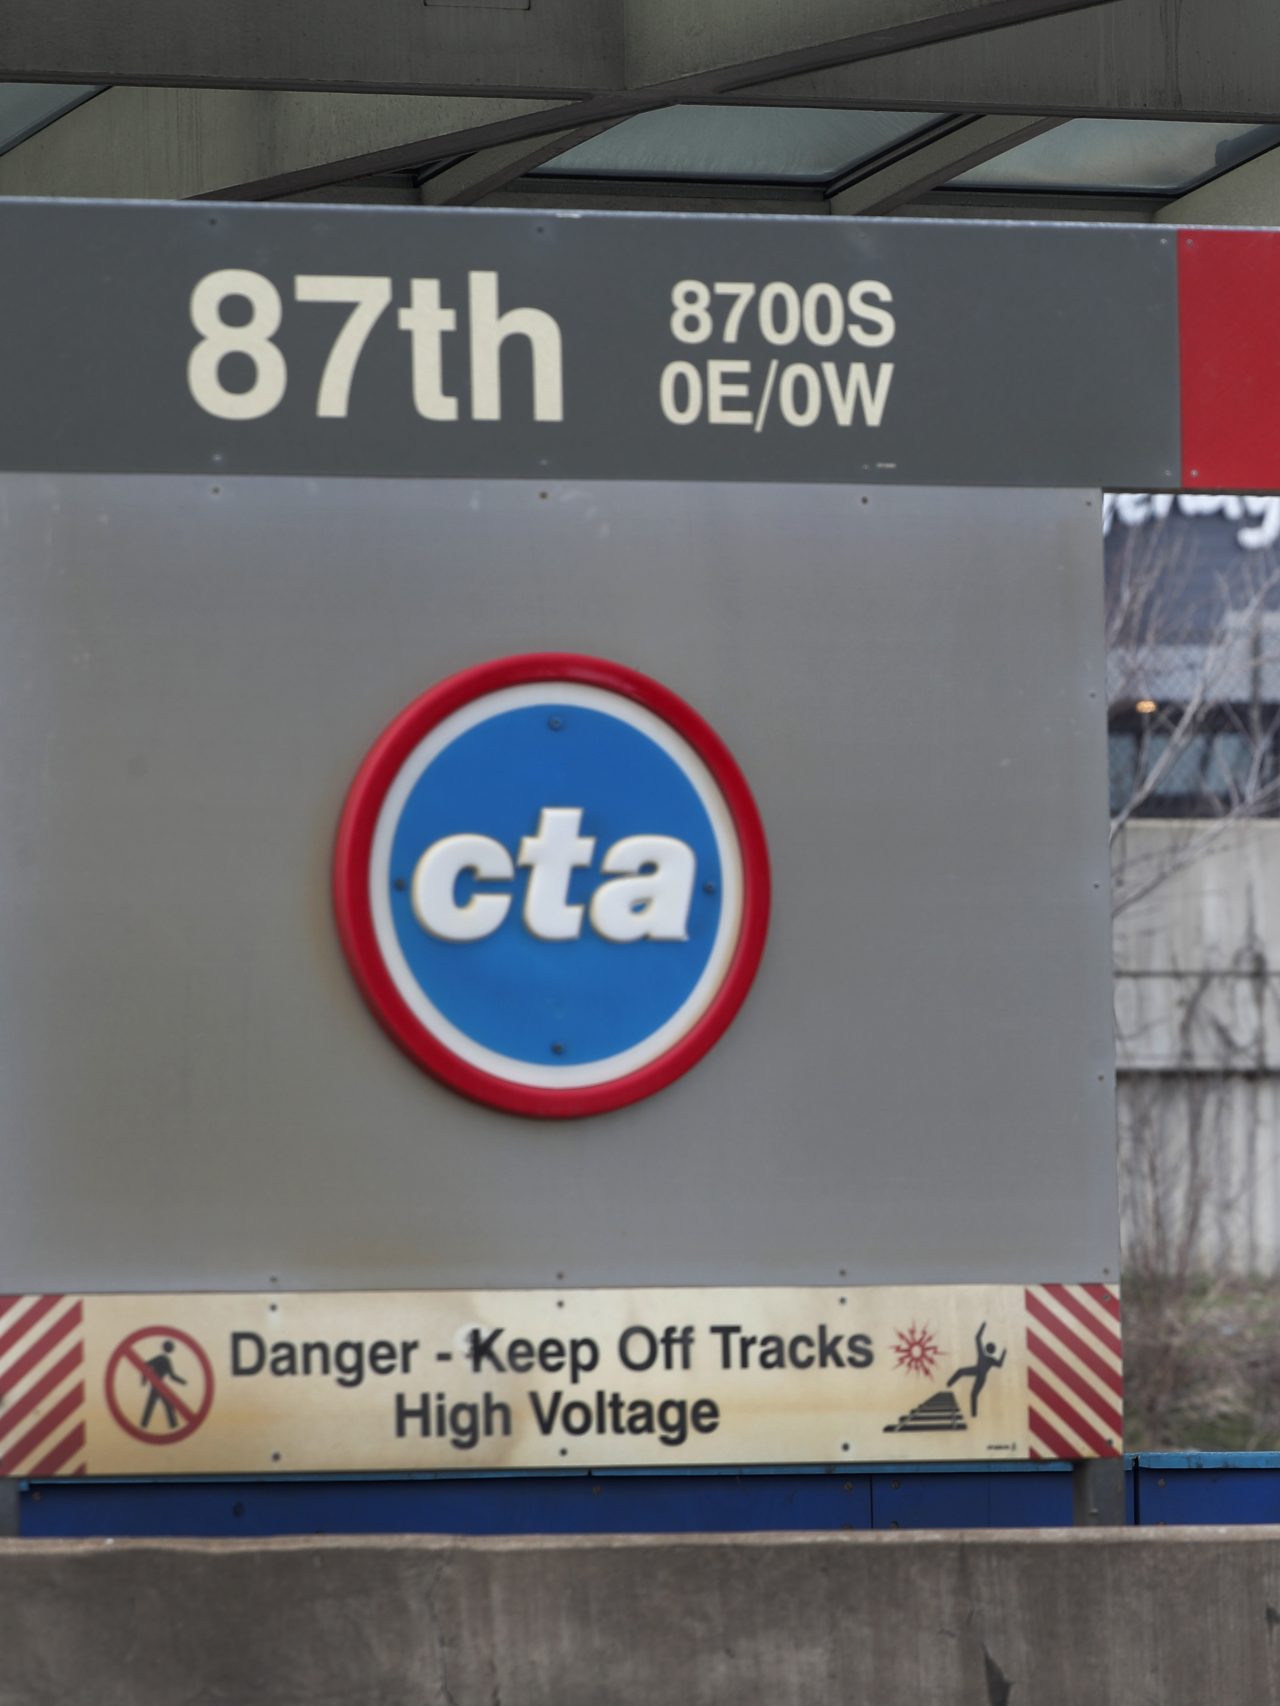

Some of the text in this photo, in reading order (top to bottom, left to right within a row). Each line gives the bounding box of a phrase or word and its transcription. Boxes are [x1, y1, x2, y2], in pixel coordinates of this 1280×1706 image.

[188, 269, 563, 422] 87th
[670, 279, 896, 347] 8700S
[660, 359, 894, 432] 0E/0W
[412, 807, 696, 941] cta
[231, 1331, 419, 1387] Danger
[471, 1328, 600, 1384] Keep
[618, 1325, 695, 1372] Off
[709, 1324, 875, 1370] Tracks
[395, 1390, 720, 1449] High Voltage
